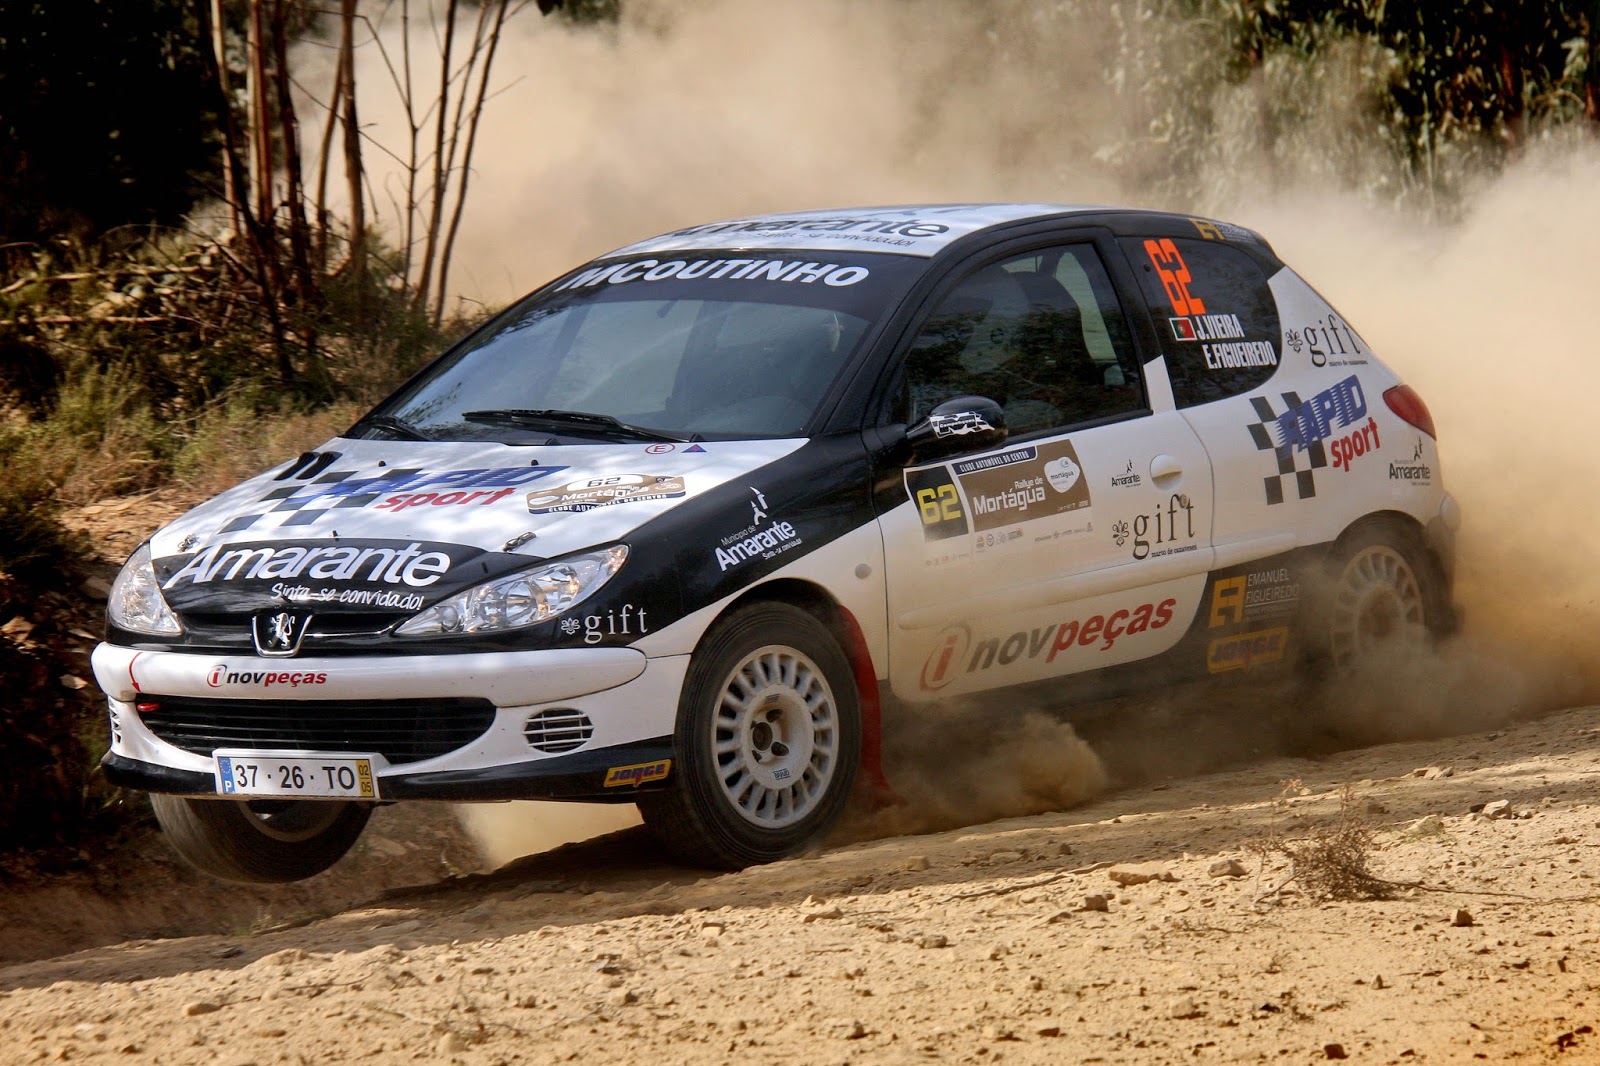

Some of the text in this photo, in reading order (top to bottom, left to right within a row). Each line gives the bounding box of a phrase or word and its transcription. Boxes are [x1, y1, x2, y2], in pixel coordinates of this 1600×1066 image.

[553, 258, 870, 293] MCOUTINHO
[1143, 238, 1207, 317] 62
[1194, 313, 1246, 341] J.VIEIRA
[1303, 313, 1361, 368] gift
[1201, 340, 1278, 370] E.FIGUEIREDO
[1274, 374, 1368, 460] RAPID
[1330, 416, 1381, 473] sport
[959, 462, 976, 473] CLUBE
[1002, 454, 1012, 463] DO
[1009, 450, 1030, 462] CENTRO
[1389, 462, 1431, 480] Amarante
[586, 477, 621, 488] 62
[1014, 479, 1035, 490] Rallye
[1034, 477, 1044, 485] de
[1111, 473, 1141, 487] Amarante
[373, 487, 517, 513] sport
[916, 483, 962, 525] 62
[973, 486, 1046, 516] Mortágua
[1132, 493, 1195, 561] gift
[714, 520, 796, 572] Amarante
[161, 542, 451, 590] Amarante
[1247, 568, 1290, 587] EMANUEL
[270, 582, 425, 611] Sinta-se convidado!
[1245, 584, 1300, 605] FIGUEIREDO
[584, 604, 649, 645] gift
[235, 764, 355, 790] 37 26 TO
[358, 764, 369, 776] 02
[224, 780, 233, 792] P
[361, 782, 372, 793] 05
